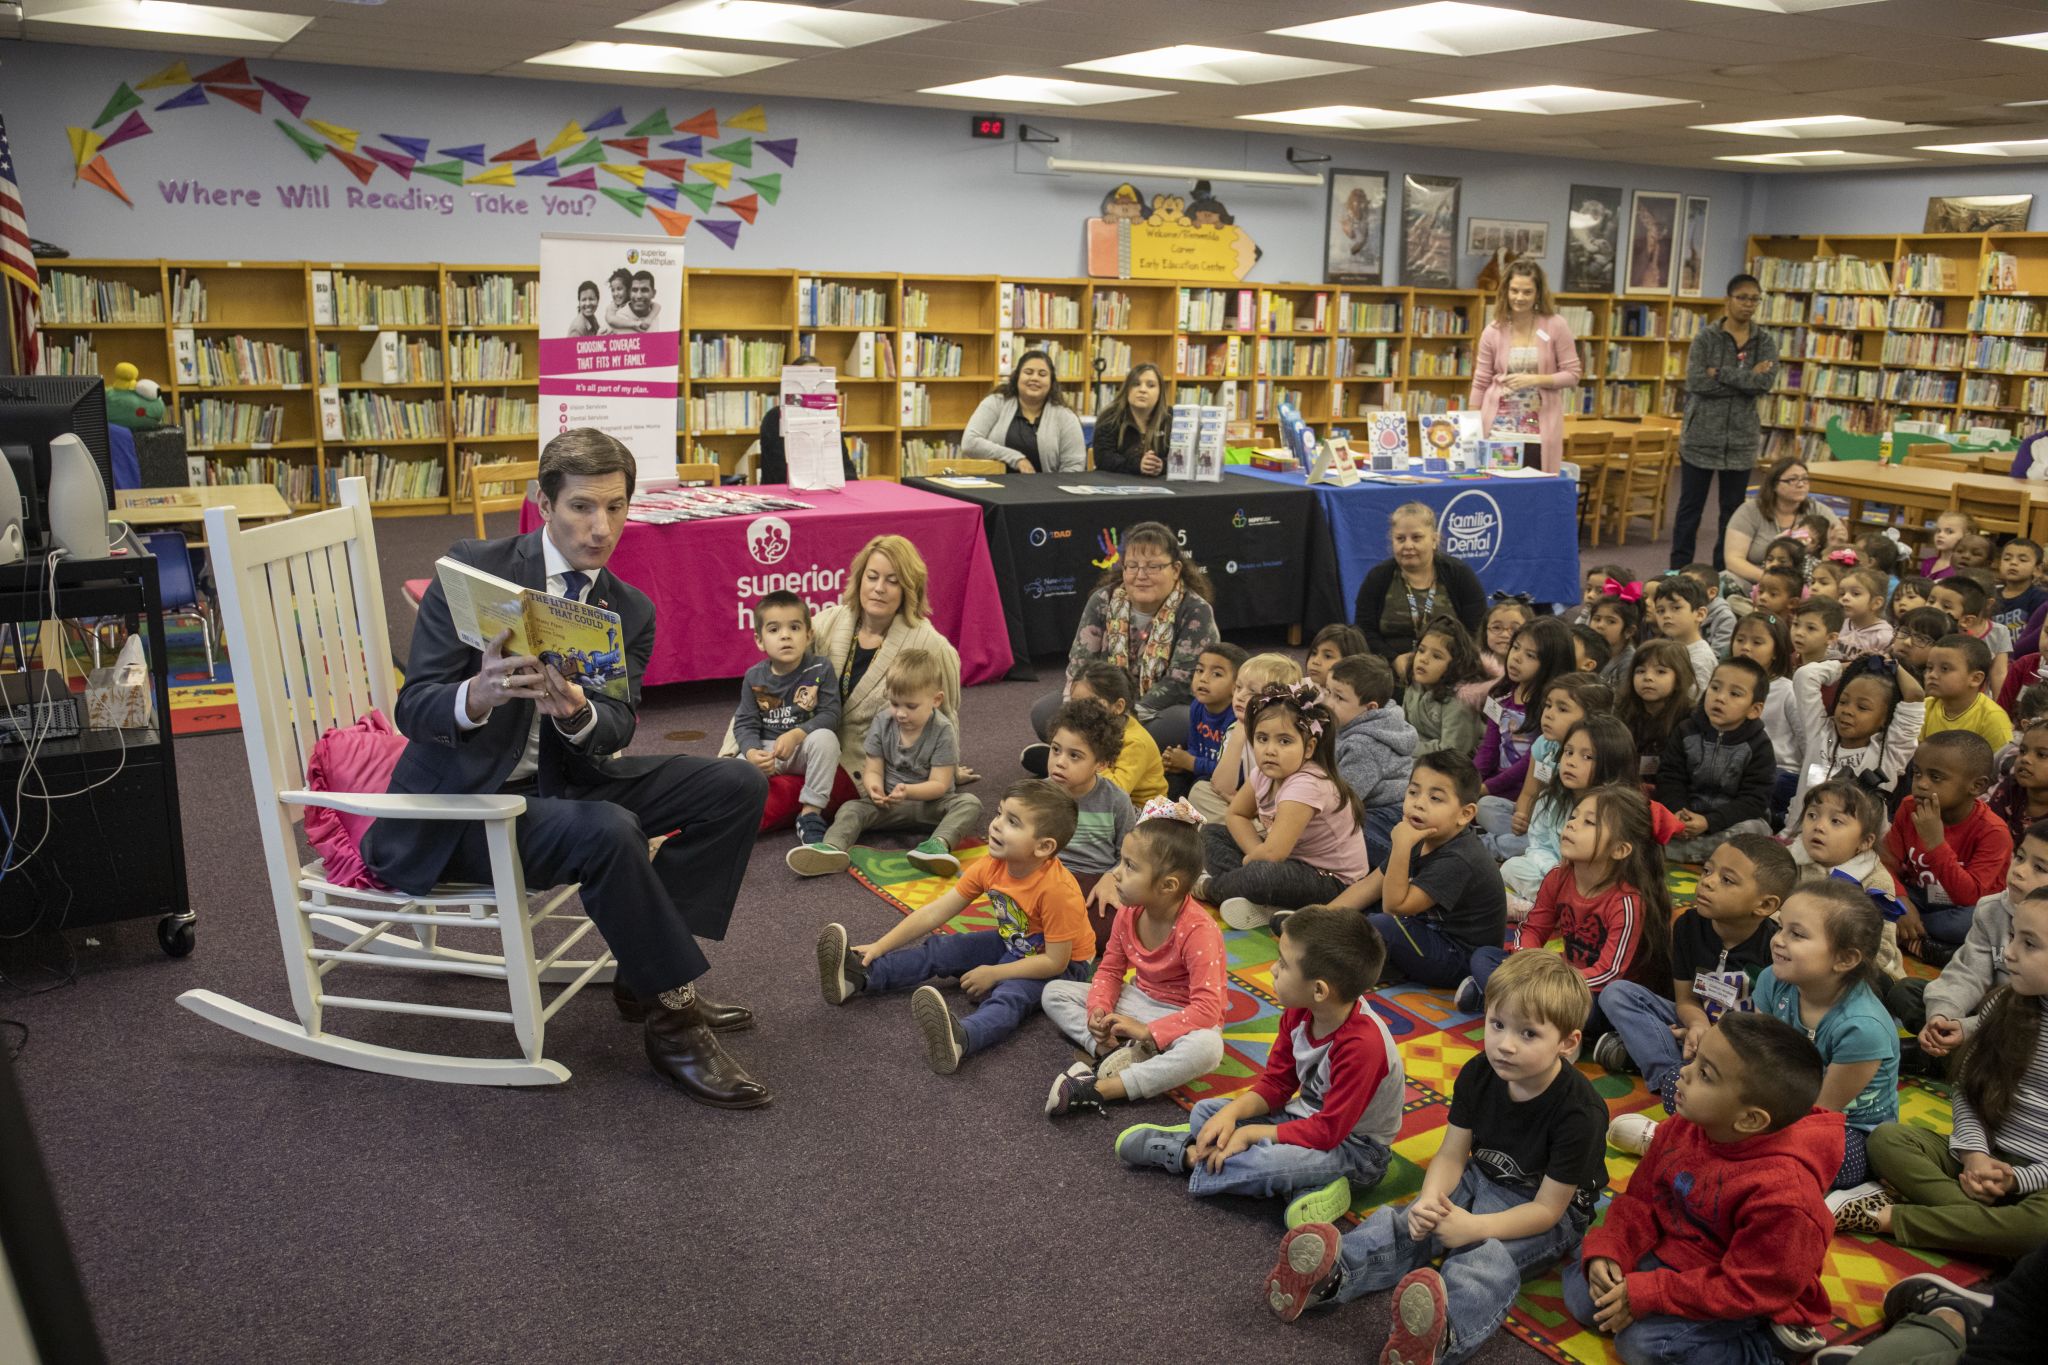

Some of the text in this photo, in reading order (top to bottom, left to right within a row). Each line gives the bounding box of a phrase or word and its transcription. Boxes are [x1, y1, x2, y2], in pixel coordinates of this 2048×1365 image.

[158, 179, 597, 217] Where Will Reading Take You?
[641, 249, 667, 258] superior
[576, 337, 640, 354] CHOOSING COVERAGE
[577, 353, 646, 370] THAT FITS MY FAMILY.
[575, 384, 649, 395] It's all part of my plan.
[1448, 511, 1493, 528] familia
[1447, 532, 1491, 552] Dental
[530, 592, 549, 605] THE
[550, 598, 581, 613] LITTLE
[581, 606, 617, 624] ENGINE
[548, 606, 573, 621] THAT
[574, 614, 604, 629] COULD
[768, 705, 792, 719] TOYS
